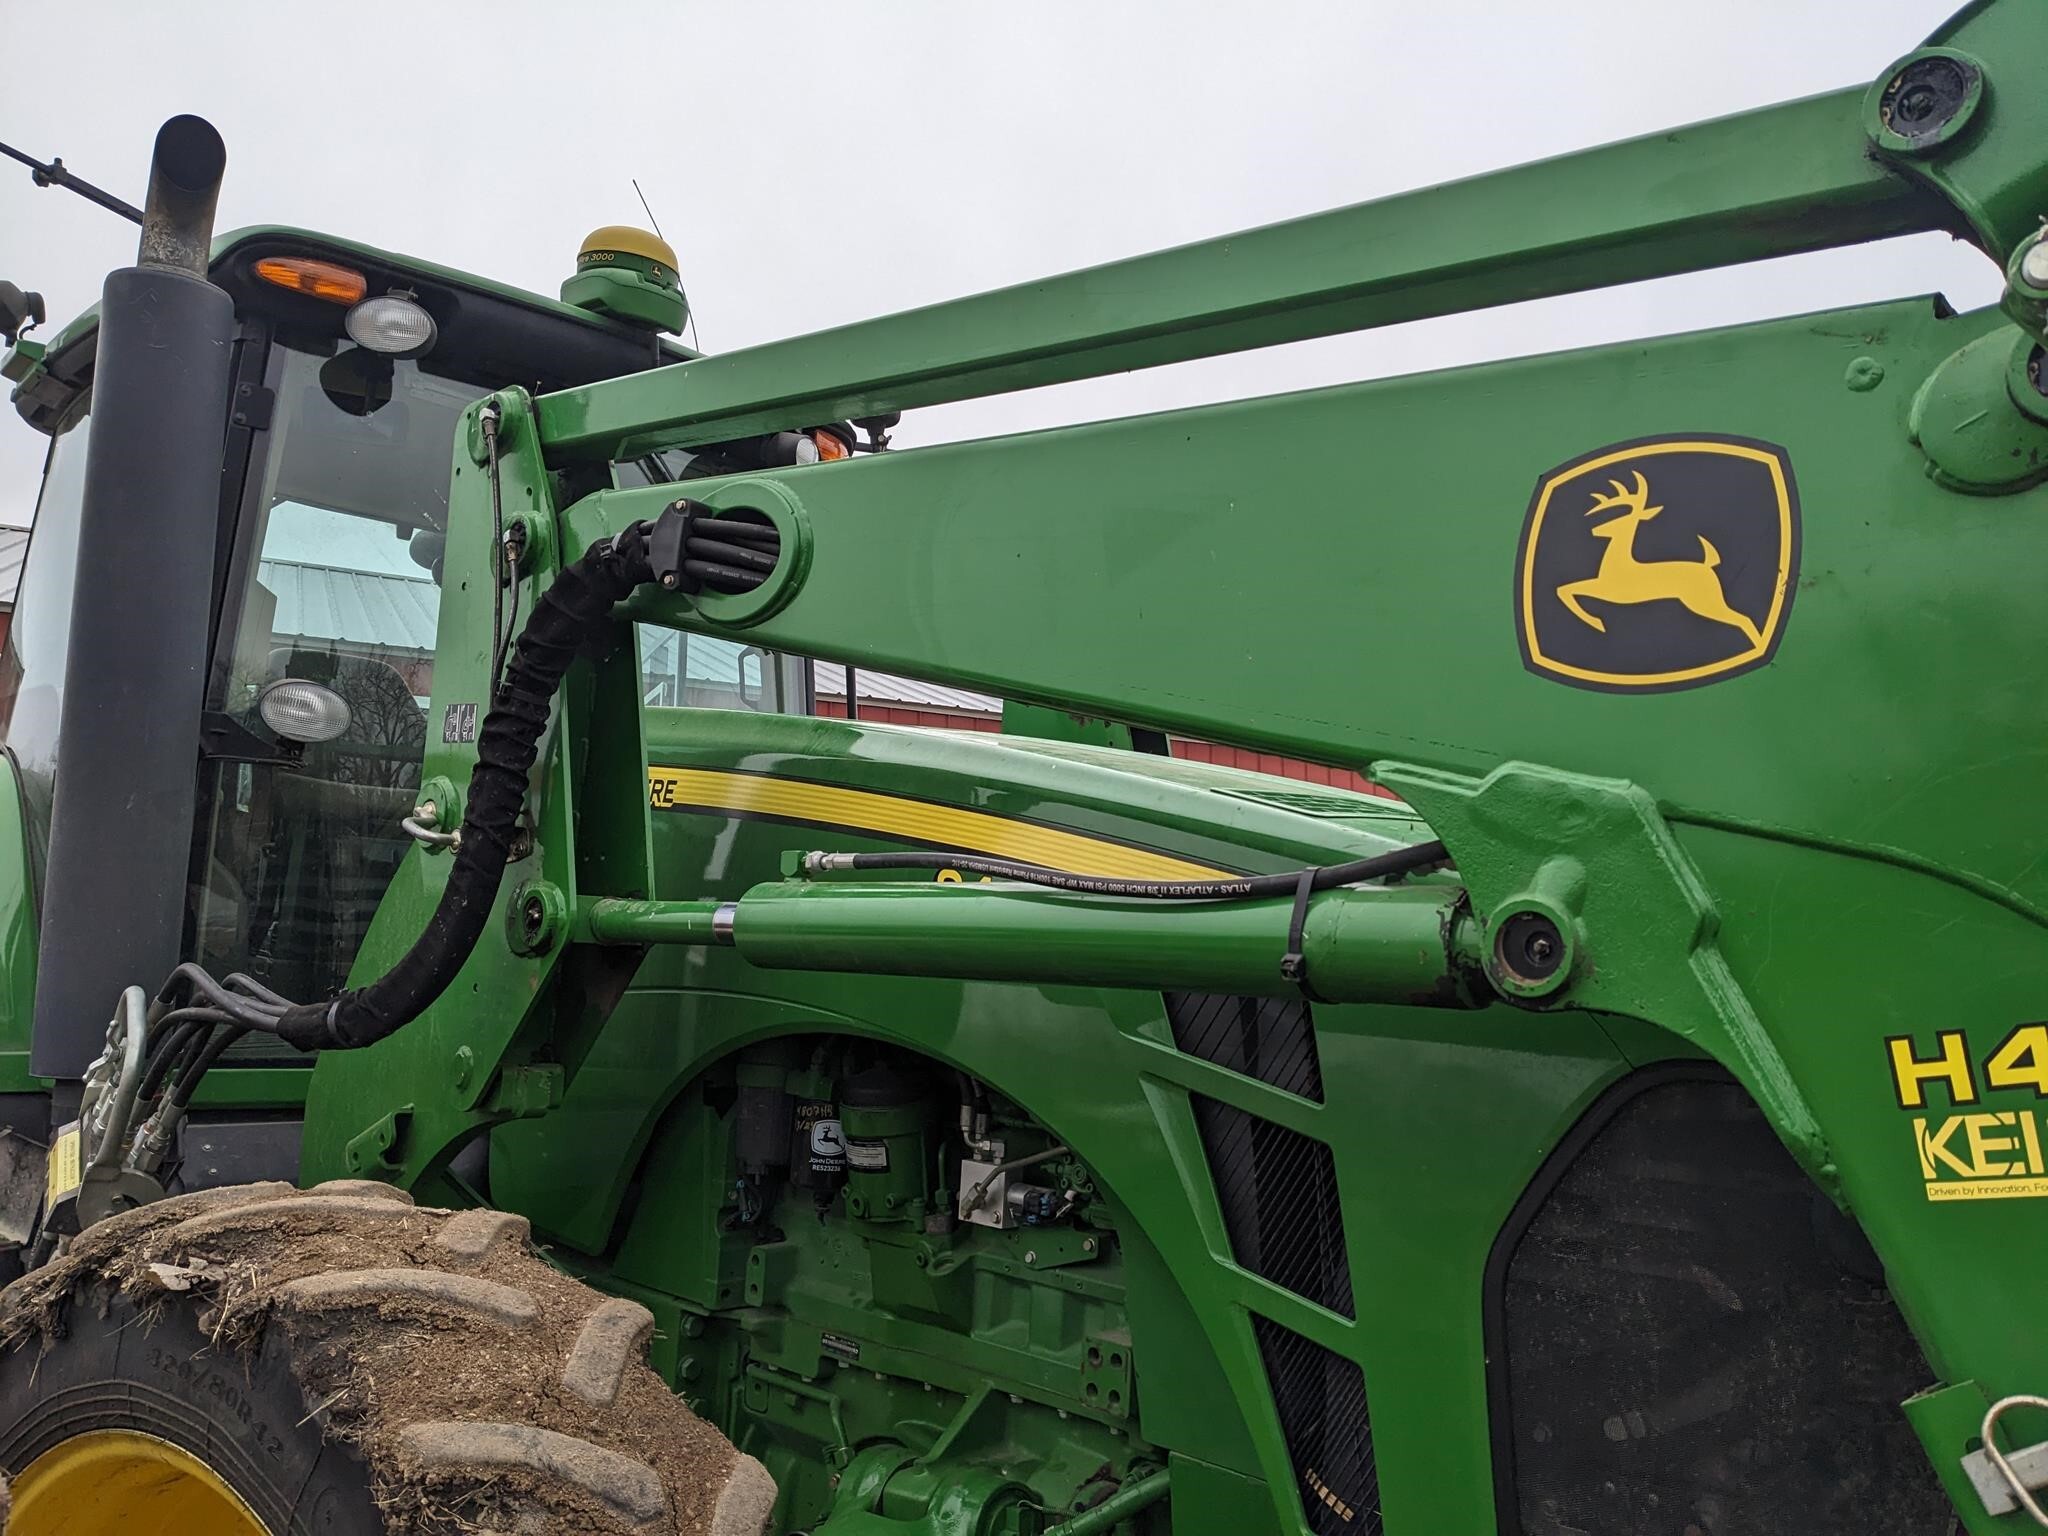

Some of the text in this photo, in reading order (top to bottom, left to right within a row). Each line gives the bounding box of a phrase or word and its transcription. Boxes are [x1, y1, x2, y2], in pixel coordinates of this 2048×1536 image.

[591, 253, 615, 261] 3000
[649, 779, 678, 803] RE
[1052, 876, 1065, 886] SAE
[1066, 879, 1078, 888] WP
[1079, 880, 1095, 889] MAX
[1095, 881, 1107, 891] PSI
[1108, 883, 1125, 892] 5000
[1127, 884, 1146, 893] INCH
[1169, 885, 1213, 894] ATLAFLEX
[1220, 882, 1251, 893] ATLAS
[1913, 1111, 2048, 1179] KEI
[809, 1156, 825, 1164] JOHN
[1929, 1186, 1961, 1196] Driven
[1963, 1184, 1975, 1196] by
